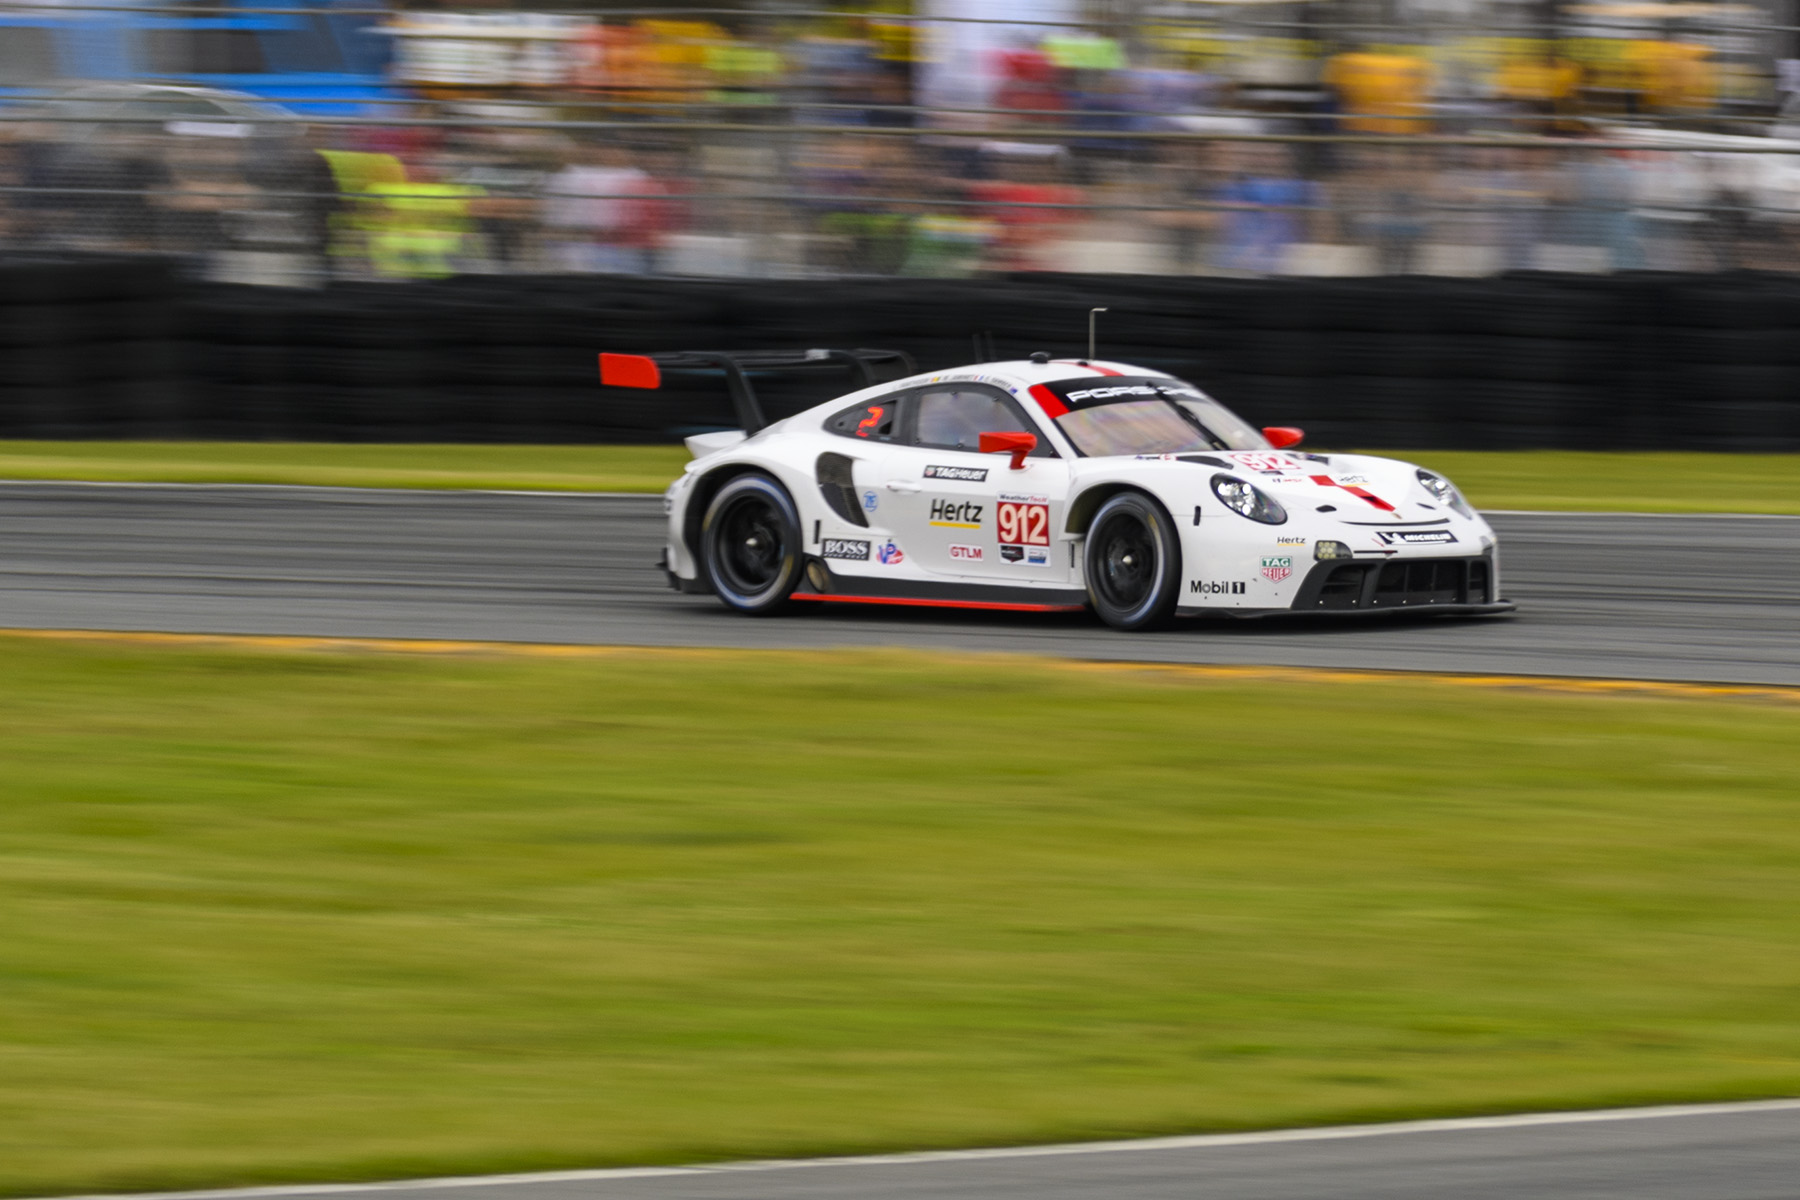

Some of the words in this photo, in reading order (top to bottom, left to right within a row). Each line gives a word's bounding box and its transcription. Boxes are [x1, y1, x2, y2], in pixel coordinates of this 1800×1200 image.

[930, 498, 983, 523] Hertz
[999, 503, 1048, 544] 912
[1277, 536, 1306, 544] Hertz
[824, 540, 868, 555] BOSS
[950, 546, 982, 559] GTLM
[1264, 558, 1290, 567] TAG
[1262, 567, 1290, 581] HEUER
[1190, 580, 1229, 594] Mobil
[1233, 582, 1244, 594] 1
